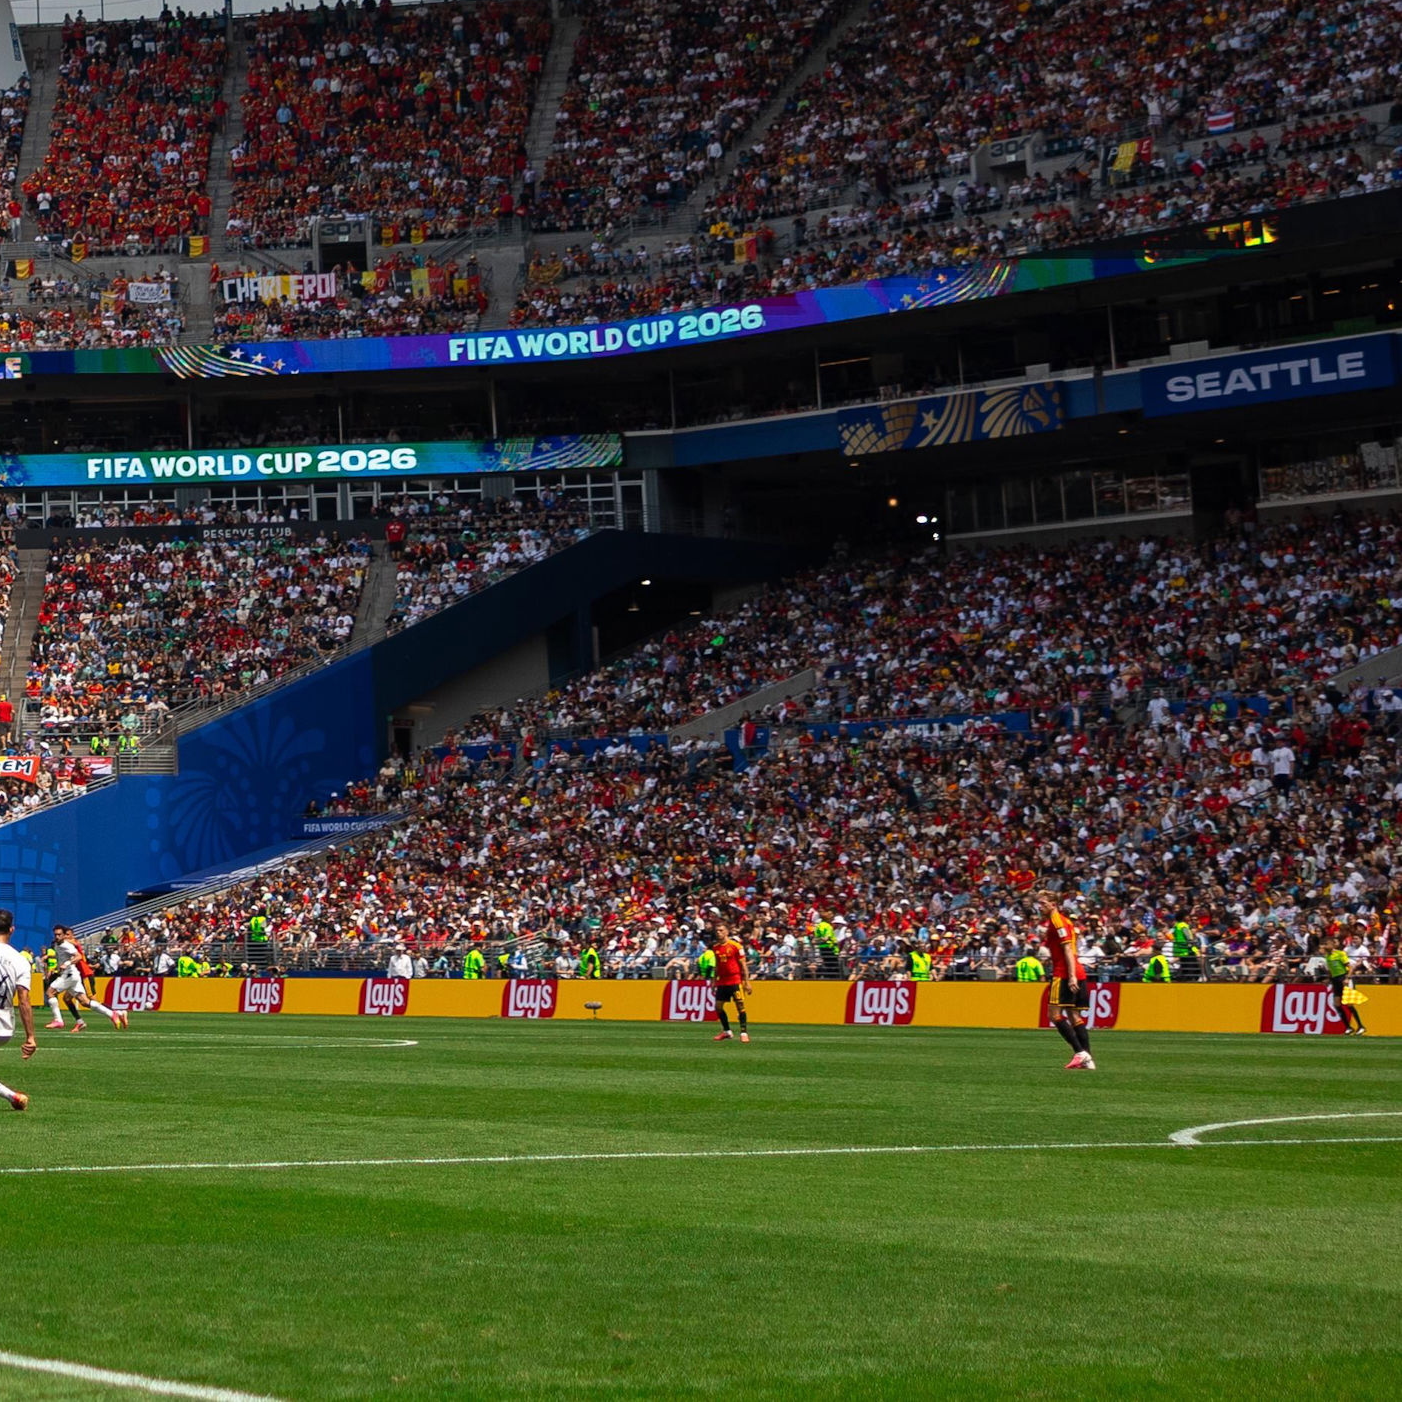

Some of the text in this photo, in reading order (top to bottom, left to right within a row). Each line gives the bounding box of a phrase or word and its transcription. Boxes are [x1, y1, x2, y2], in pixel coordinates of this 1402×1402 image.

[321, 221, 364, 236] 301
[449, 305, 764, 361] FIFA WORLD CUP 2026
[1166, 352, 1366, 403] SEATTLE
[87, 448, 417, 479] FIFA WORLD CUP 2026
[304, 823, 321, 833] FIFA
[322, 822, 349, 832] WORLD
[111, 977, 159, 1011] Lay's
[244, 978, 280, 1013] Lay's
[365, 978, 405, 1016] Lay's
[508, 979, 552, 1018] Lay's
[854, 981, 909, 1025] Lay's
